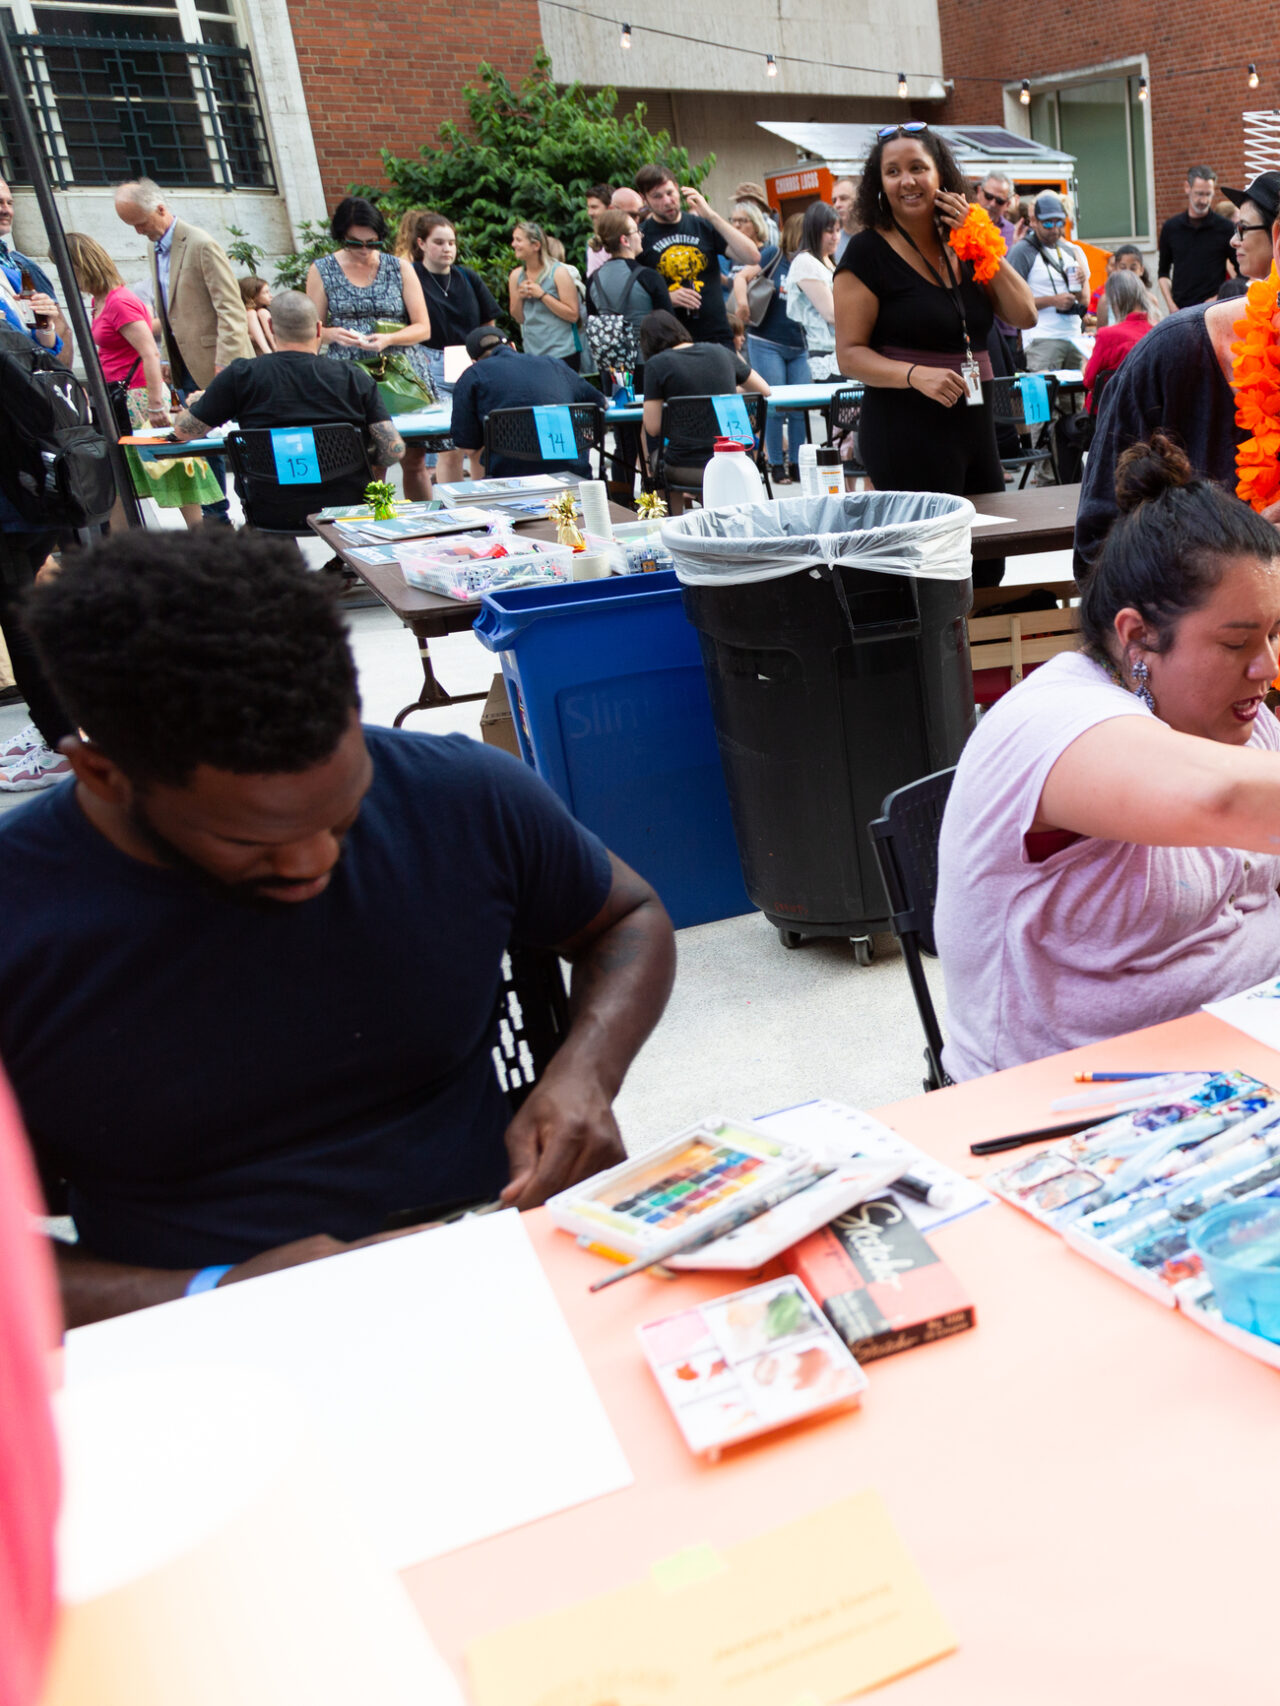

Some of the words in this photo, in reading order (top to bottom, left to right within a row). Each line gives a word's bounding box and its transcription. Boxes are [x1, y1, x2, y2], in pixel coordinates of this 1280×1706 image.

[1030, 404, 1041, 420] 11
[727, 420, 744, 441] 13
[548, 433, 565, 454] 14
[287, 458, 309, 478] 15
